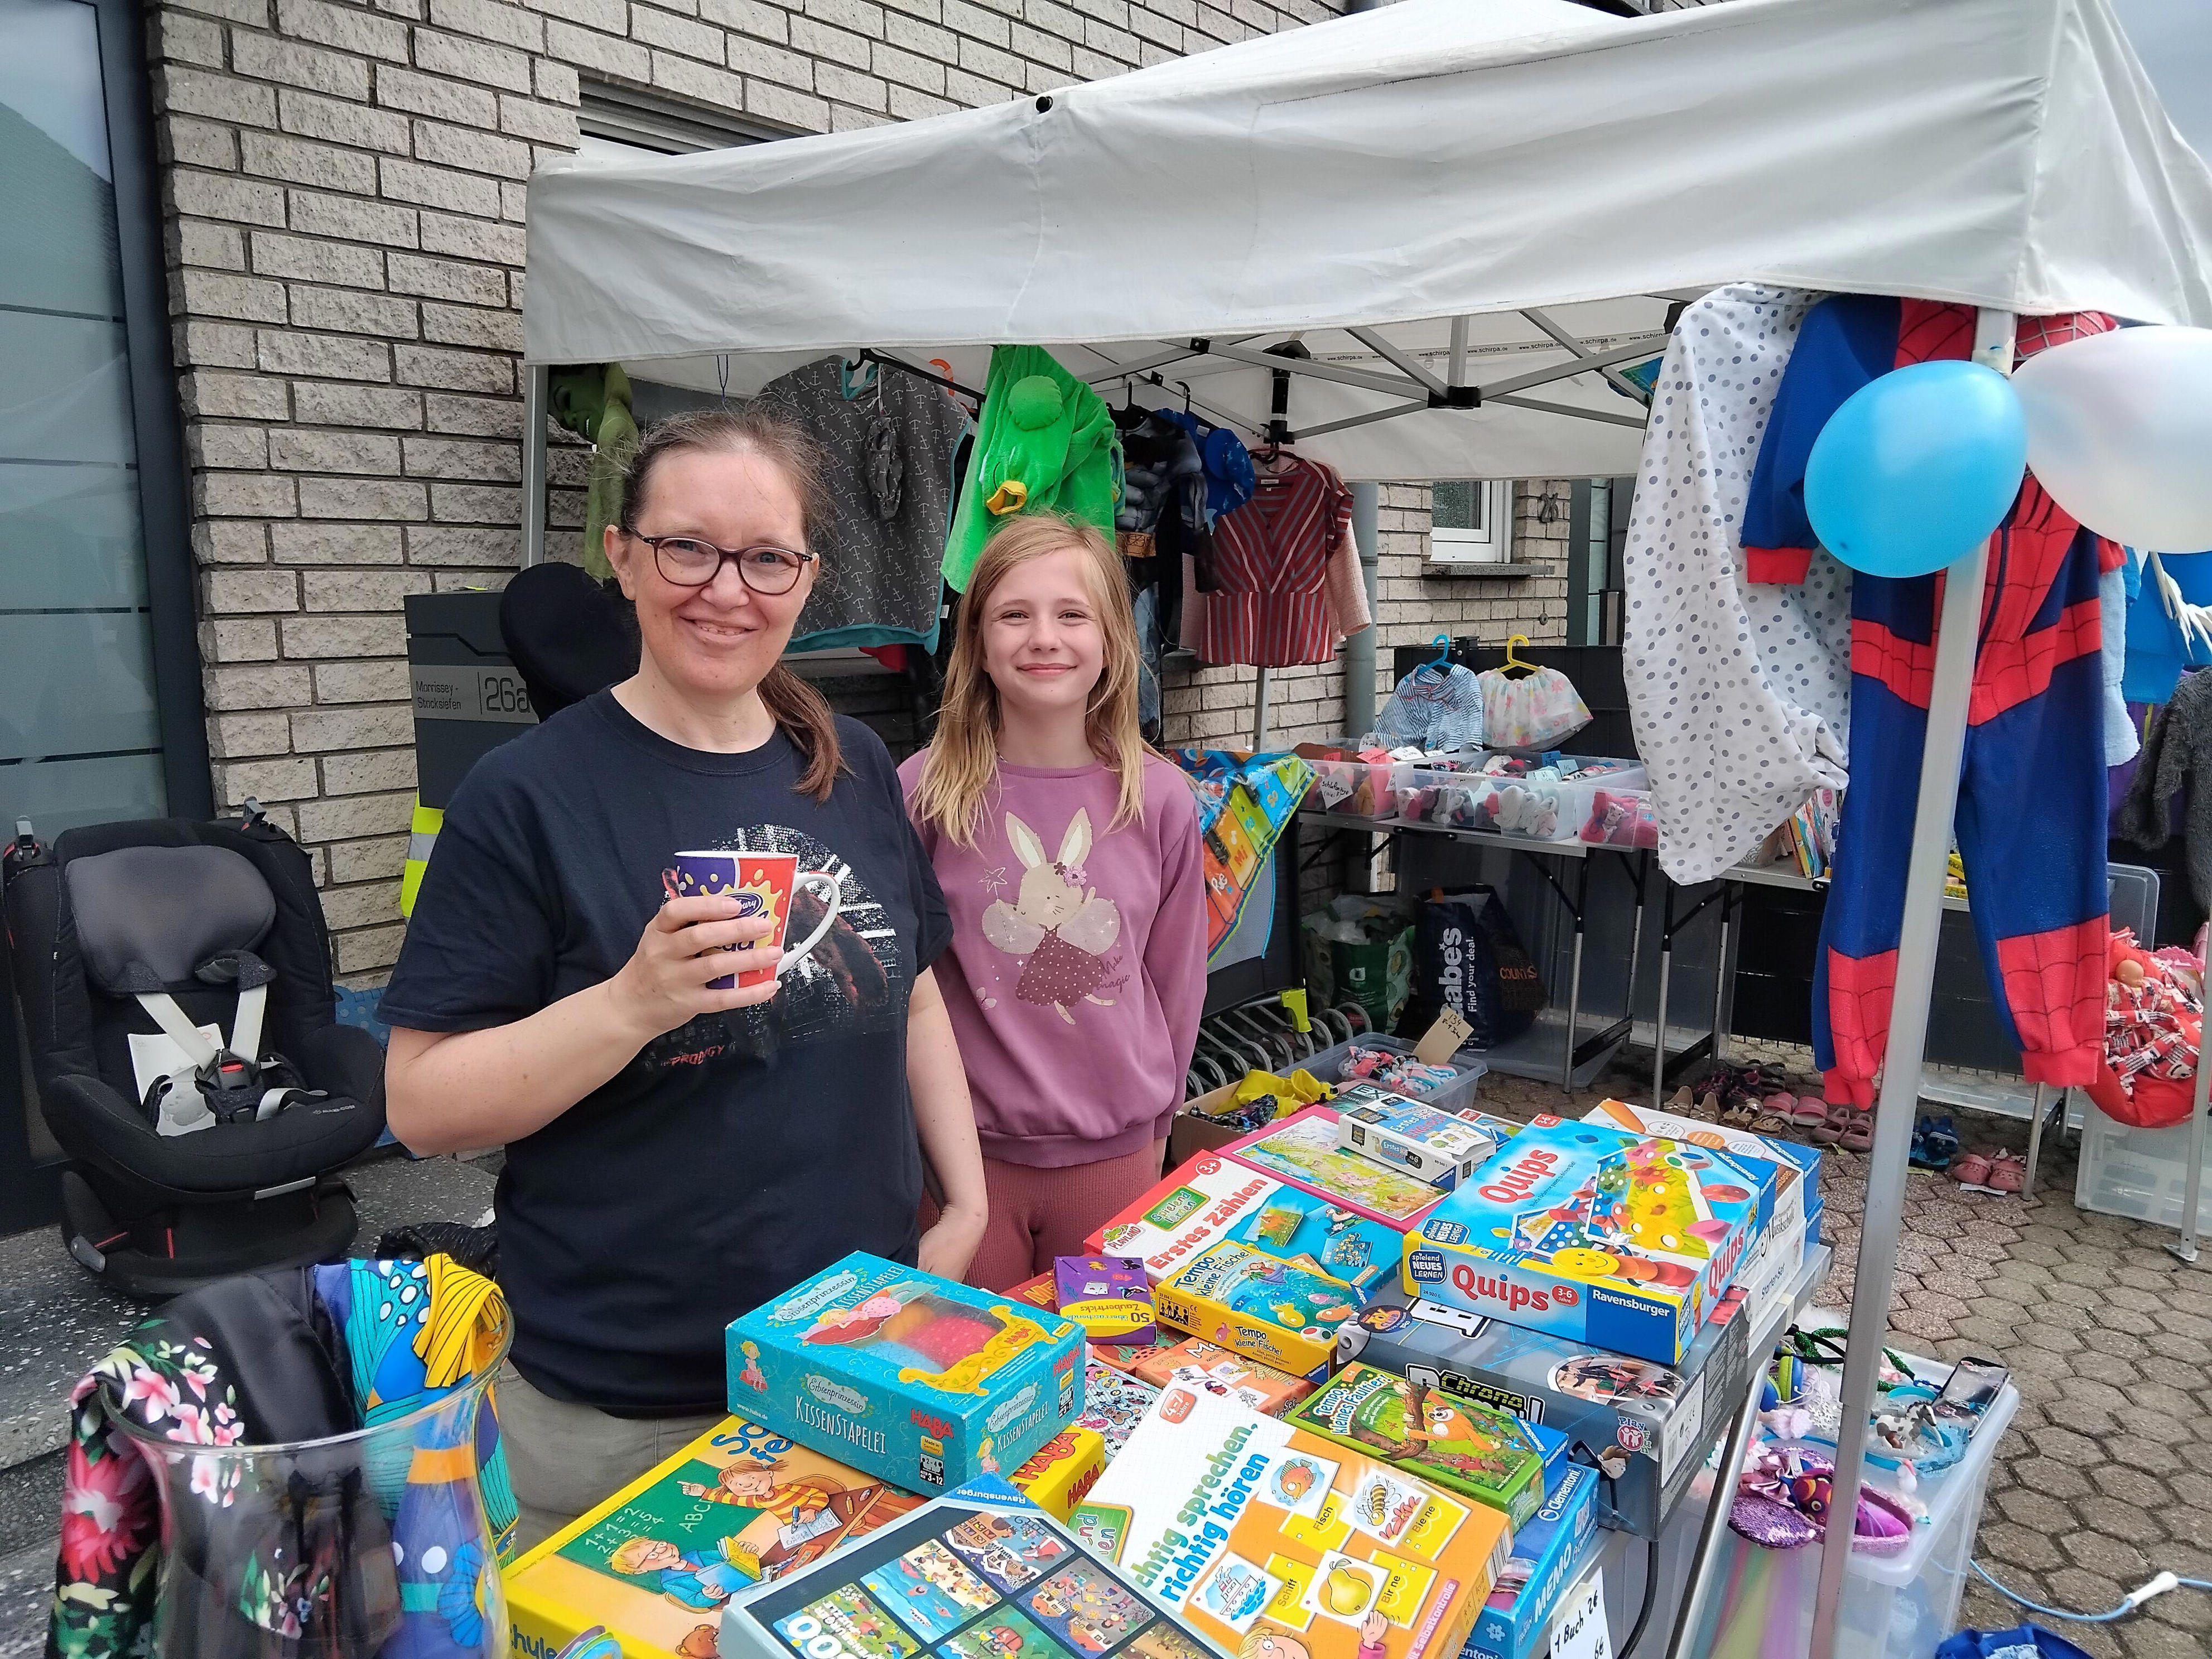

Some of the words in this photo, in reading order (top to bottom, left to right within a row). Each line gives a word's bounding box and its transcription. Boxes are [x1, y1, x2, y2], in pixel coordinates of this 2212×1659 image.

[416, 681, 453, 696] Morrissey
[484, 677, 531, 713] 26a
[417, 697, 462, 710] Stocksiefen
[1467, 935, 1477, 960] deal.
[1468, 961, 1477, 988] your
[1467, 989, 1477, 1012] Find
[1389, 1116, 1420, 1132] Erstes
[1765, 1137, 1804, 1165] Ravensburger
[1198, 1161, 1218, 1174] 3+
[1478, 1149, 1558, 1204] Quips
[1716, 1151, 1760, 1181] Ravensburger
[1150, 1190, 1192, 1222] Spielend
[1165, 1200, 1196, 1223] lernen
[1108, 1226, 1141, 1250] PLAYLAND
[1145, 1226, 1211, 1270] Erstes
[1412, 1252, 1440, 1263] spielend
[1413, 1262, 1442, 1271] NEUES
[1708, 1227, 1744, 1299] Quips
[1173, 1256, 1223, 1289] Tempo,
[1194, 1271, 1221, 1297] kleine
[1212, 1248, 1252, 1273] Fische!
[1414, 1270, 1443, 1279] LERNEN
[1452, 1263, 1549, 1311] Quips
[1557, 1287, 1573, 1299] 3-6
[1080, 1304, 1140, 1313] Zaubertricks
[1592, 1289, 1670, 1317] Ravensburger
[1130, 1312, 1150, 1323] 50
[1004, 1327, 1032, 1344] HABA
[1234, 1338, 1256, 1348] kleine
[1257, 1339, 1283, 1356] Fische!
[1235, 1325, 1270, 1343] Tempo,
[1053, 1344, 1081, 1377] HABA
[808, 1378, 864, 1411] Erbsenprinzessin
[1163, 1392, 1185, 1418] 4-7
[1315, 1388, 1348, 1415] Tempo,
[1331, 1404, 1355, 1435] kleines
[1345, 1374, 1392, 1404] Faultier!
[1442, 1375, 1523, 1408] Chrono
[736, 1402, 769, 1421] www.haba.de
[1175, 1401, 1191, 1419] Jahre
[1618, 1416, 1646, 1431] Play
[796, 1395, 886, 1454] KISSENSTAPELEI
[910, 1409, 955, 1440] HABA
[1013, 1432, 1081, 1480] HABA
[956, 1488, 1027, 1505] Ravensburger
[1067, 1463, 1100, 1510] HABA
[1135, 1527, 1189, 1590] chtig
[1177, 1422, 1260, 1528] sprechen,
[1313, 1506, 1334, 1531] Fisch
[1160, 1517, 1229, 1603] richtig
[1211, 1453, 1270, 1522] hören
[1277, 1577, 1298, 1608] Schiff
[1534, 1541, 1572, 1623] MEMO
[1415, 1582, 1457, 1651] Selbstkontrolle
[1563, 1609, 1584, 1645] Buch
[787, 1615, 856, 1659] 00
[1459, 1646, 1500, 1659] entoni
